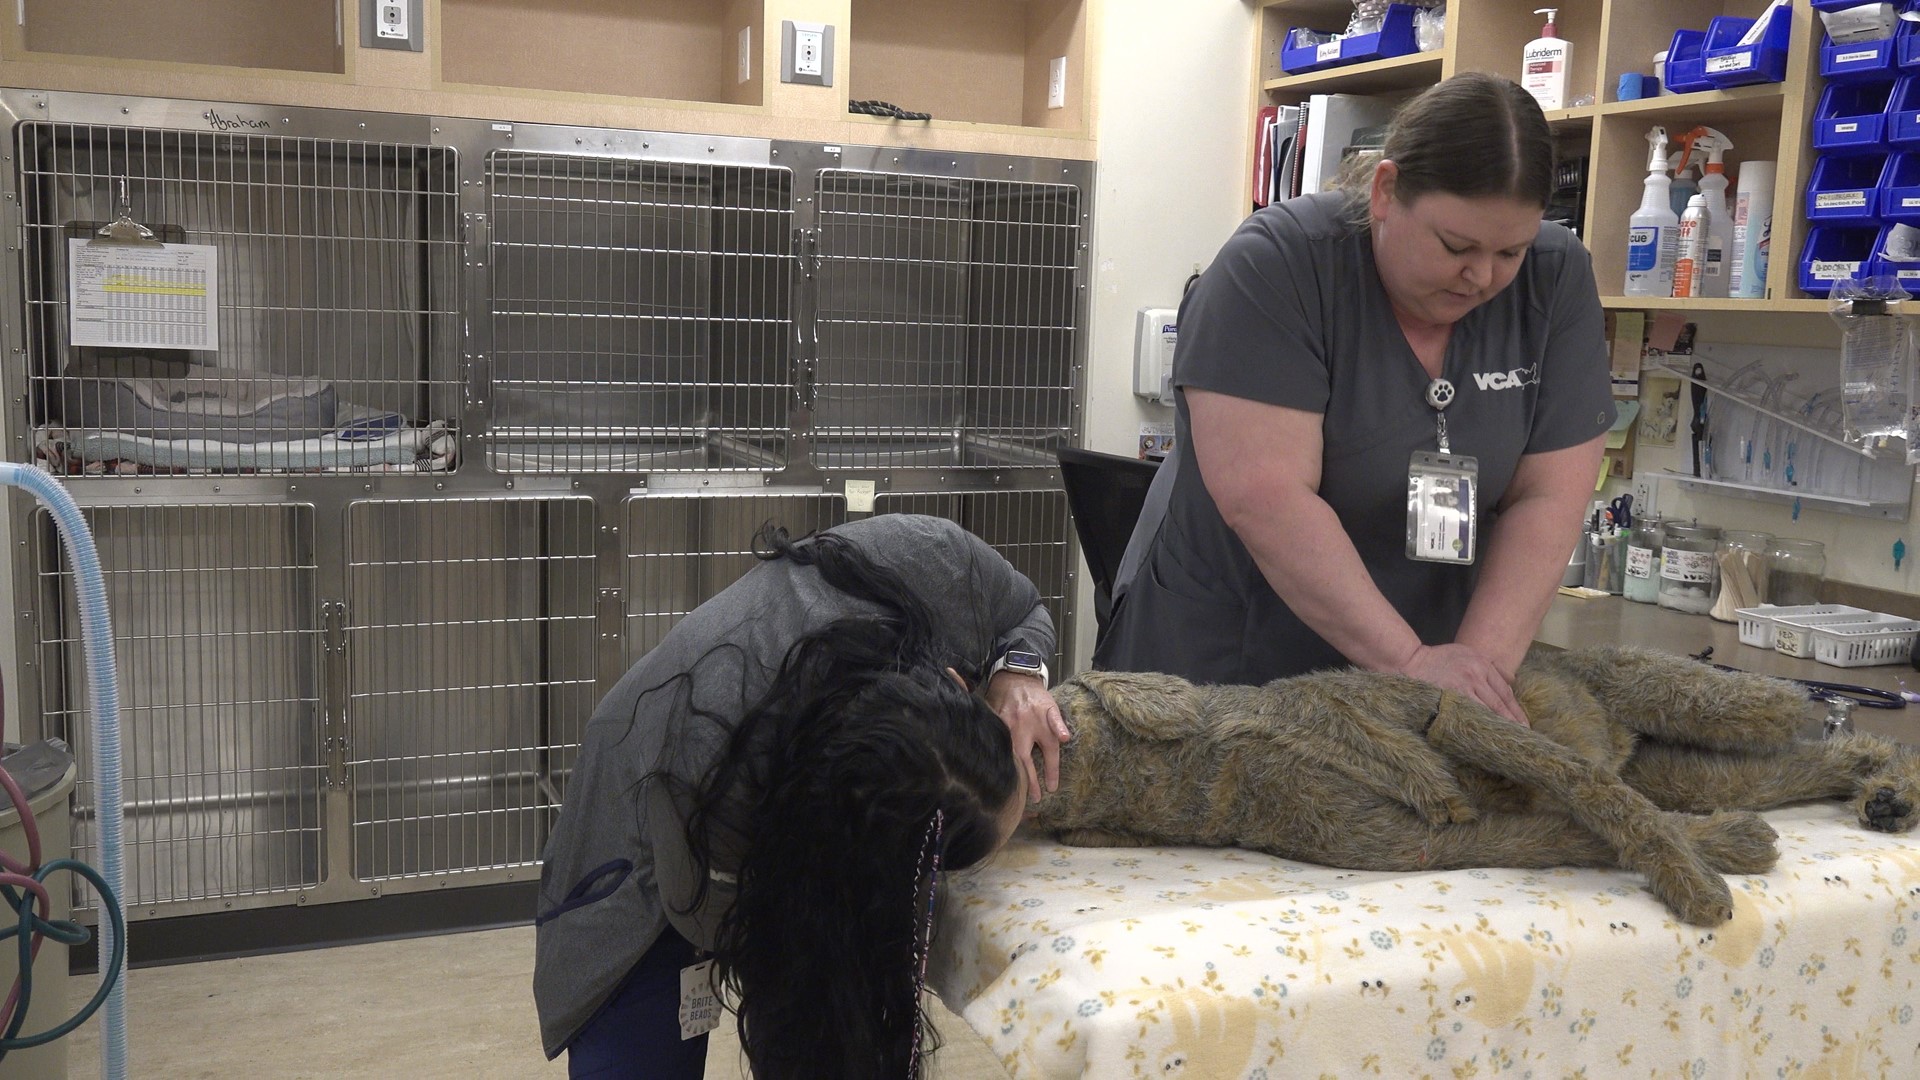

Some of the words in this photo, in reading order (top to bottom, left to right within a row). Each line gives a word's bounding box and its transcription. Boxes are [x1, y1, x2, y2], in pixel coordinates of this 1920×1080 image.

[1525, 48, 1562, 58] Lubriderm
[210, 108, 271, 131] Abraham
[1472, 370, 1523, 391] VCA
[691, 996, 713, 1009] BRITE
[690, 1008, 712, 1020] BEADS
